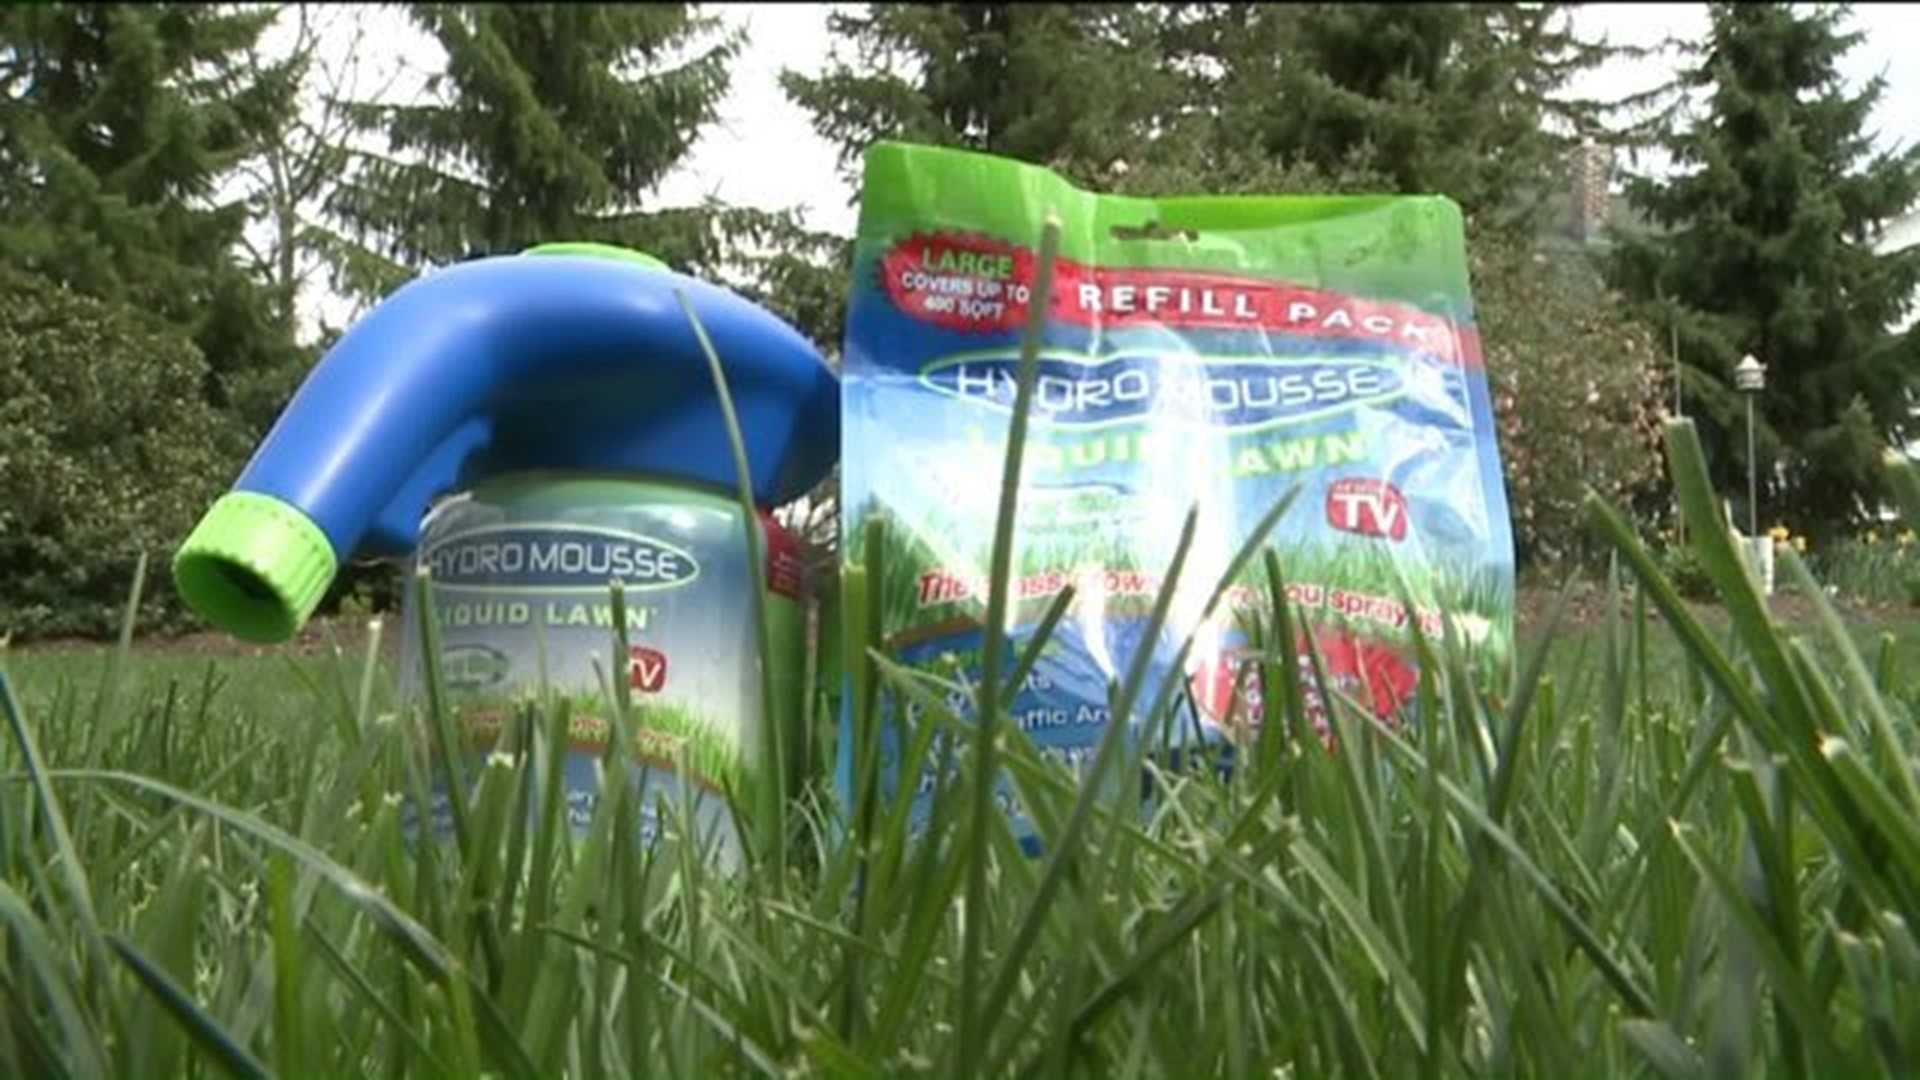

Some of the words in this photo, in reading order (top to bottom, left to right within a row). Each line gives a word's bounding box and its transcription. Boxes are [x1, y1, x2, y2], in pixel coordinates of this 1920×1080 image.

[922, 248, 1013, 279] LARGE
[902, 271, 974, 295] COVERS
[976, 279, 1001, 297] UP
[1006, 283, 1030, 304] TO
[1078, 284, 1257, 318] REFILL
[1288, 303, 1433, 341] PACK
[957, 364, 1150, 412] HDRO
[1154, 366, 1382, 412] OUSSE
[1332, 492, 1399, 533] TV
[430, 542, 523, 576] HYDRO
[529, 543, 678, 580] MOUSSE
[546, 603, 647, 629] LAWN
[919, 572, 970, 602] The
[1331, 589, 1405, 627] spray
